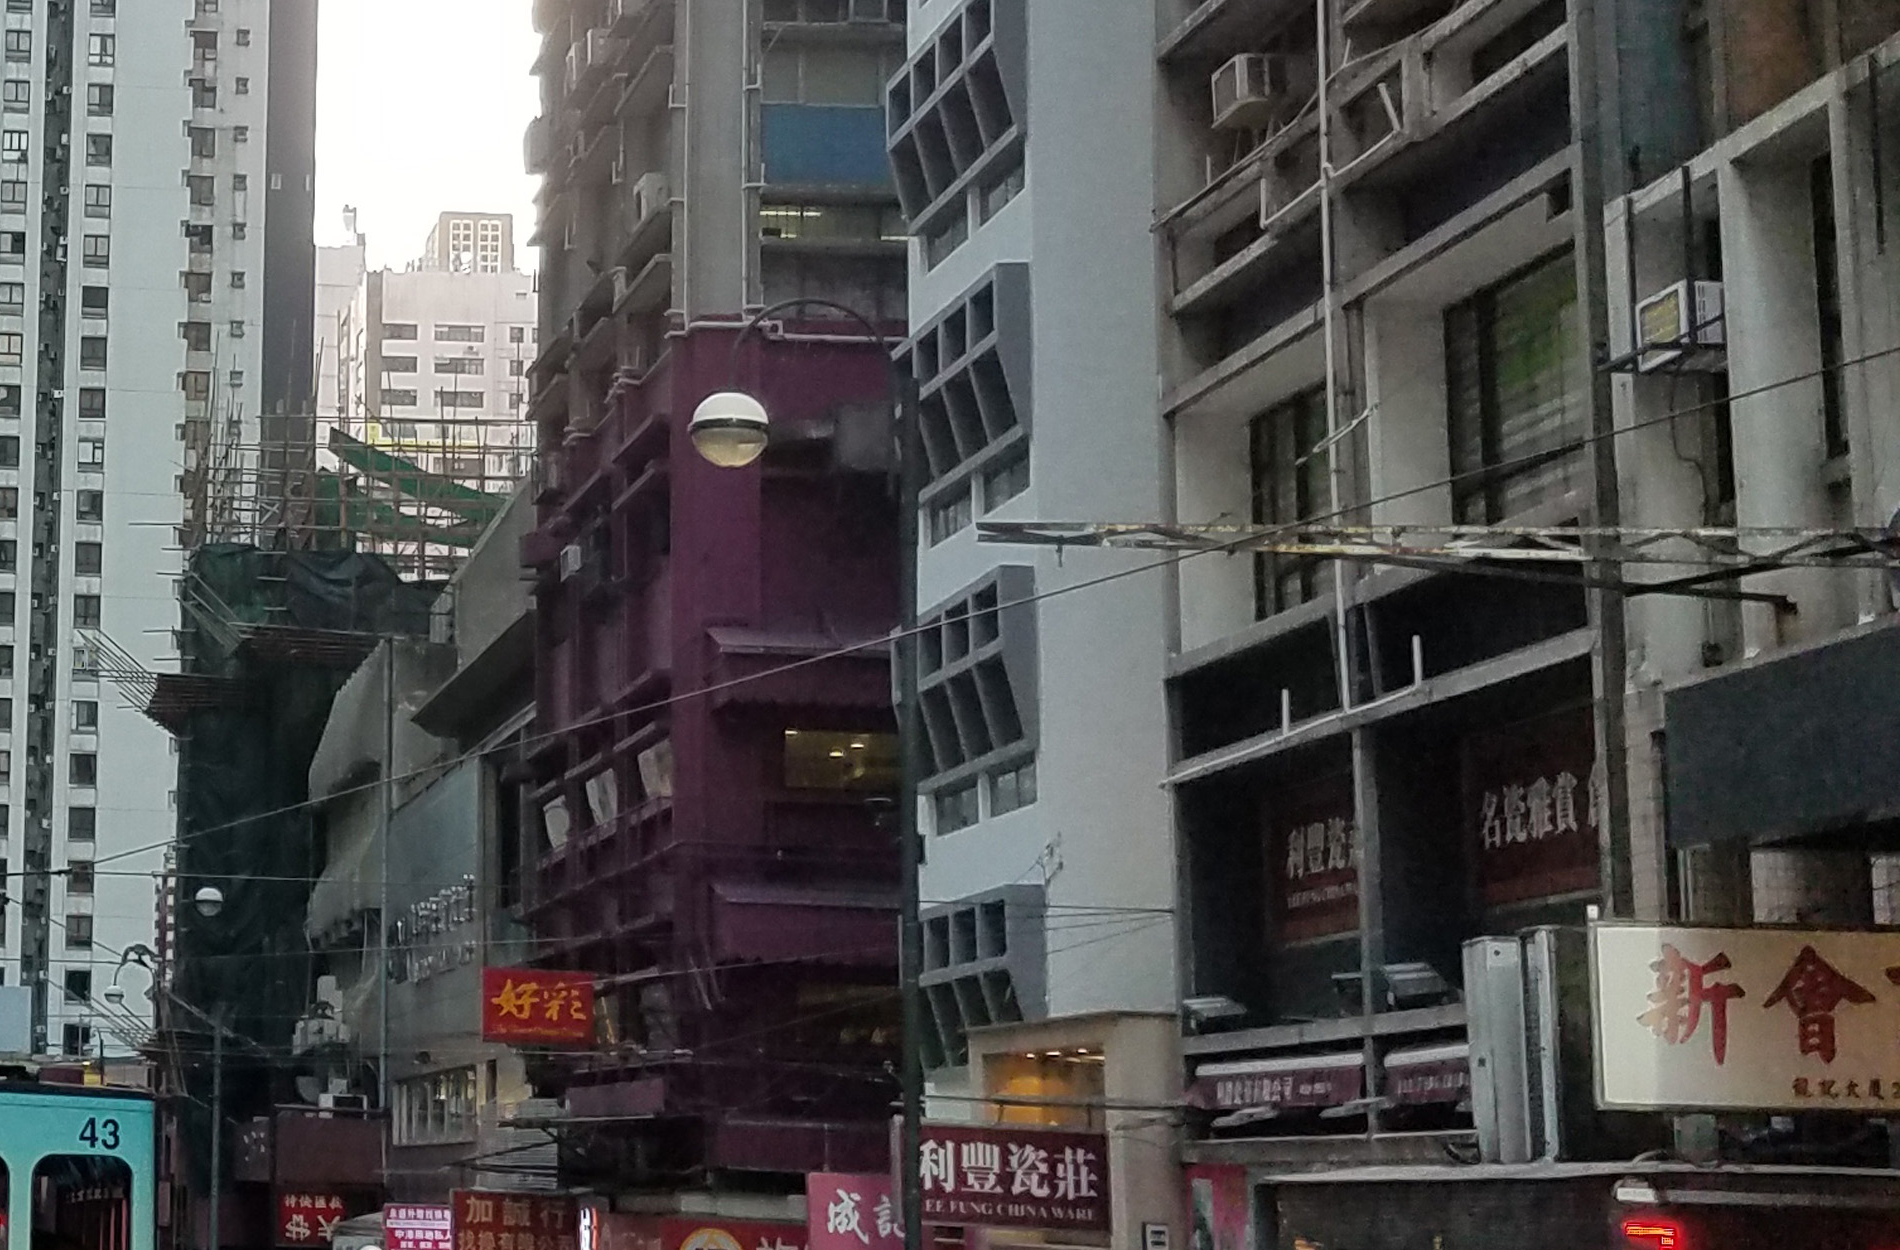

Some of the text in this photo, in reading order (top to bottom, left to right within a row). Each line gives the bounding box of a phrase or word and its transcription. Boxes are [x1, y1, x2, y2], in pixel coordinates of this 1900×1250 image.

[1636, 943, 1900, 1066] 新會
[79, 1117, 120, 1150] 43
[920, 1139, 1098, 1200] 利豐瓷莊
